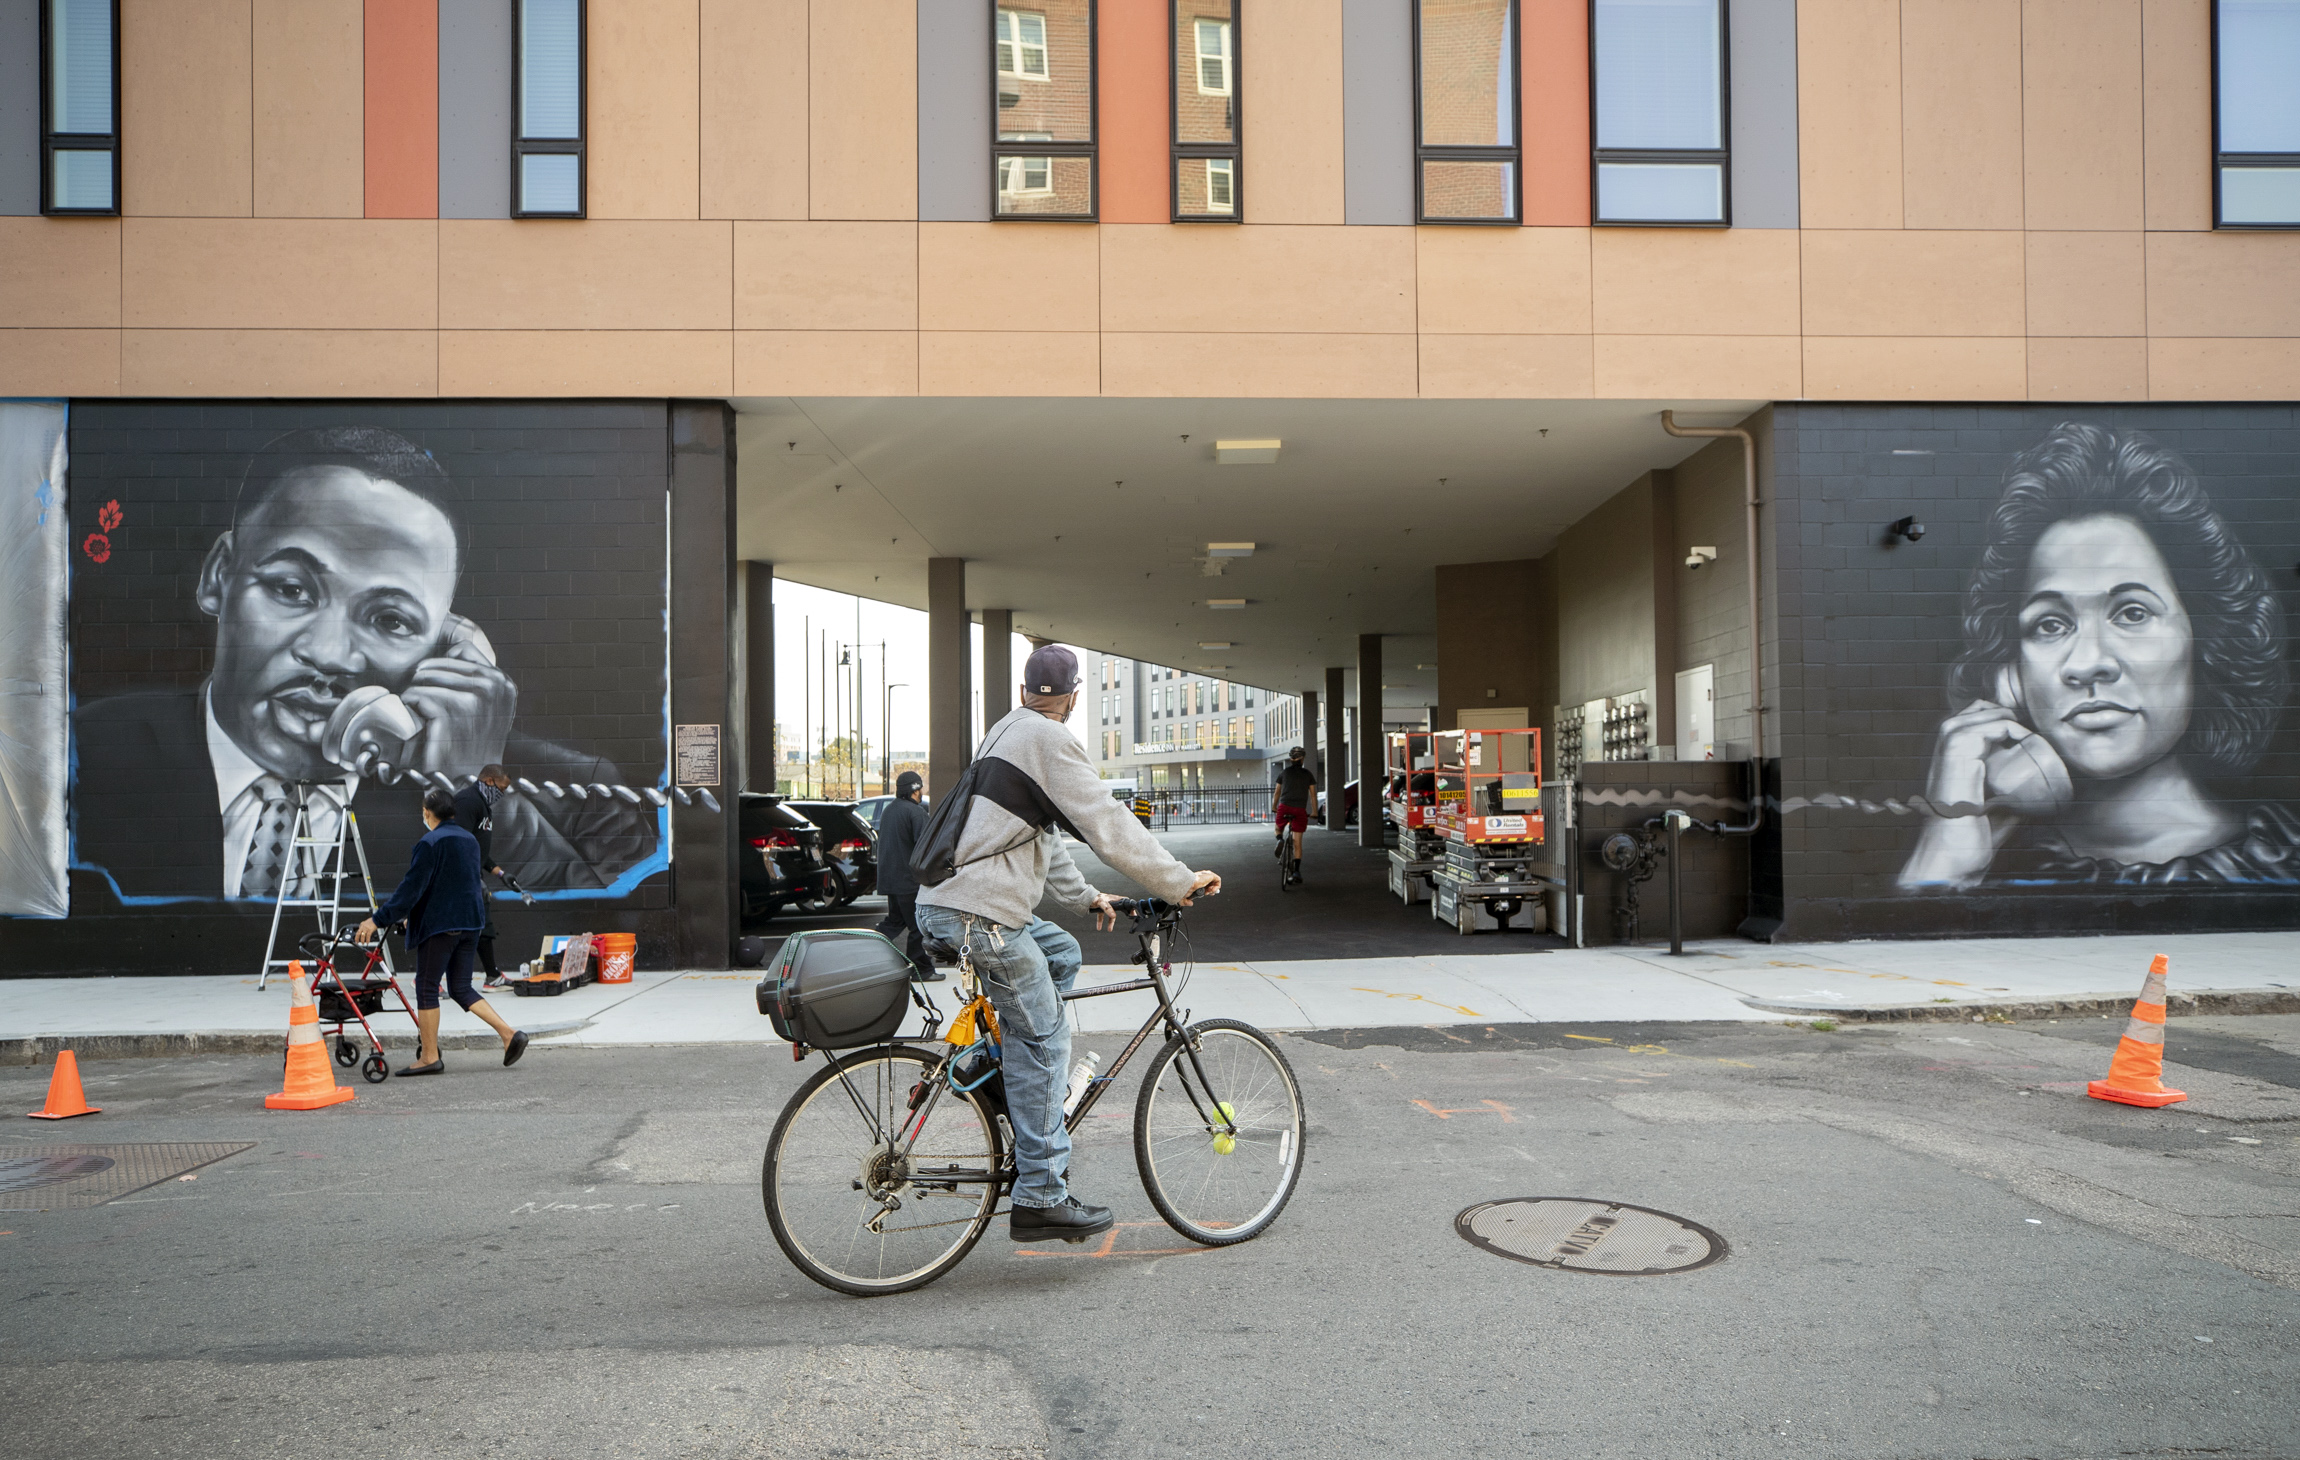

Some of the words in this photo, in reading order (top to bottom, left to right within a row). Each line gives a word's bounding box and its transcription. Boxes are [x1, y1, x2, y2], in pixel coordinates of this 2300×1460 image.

[1134, 742, 1166, 755] Residence
[1503, 789, 1538, 797] 10611556
[1087, 982, 1136, 996] SPECIALIZED
[1100, 1031, 1146, 1090] CROSSROADS
[1564, 1222, 1611, 1251] CATV
